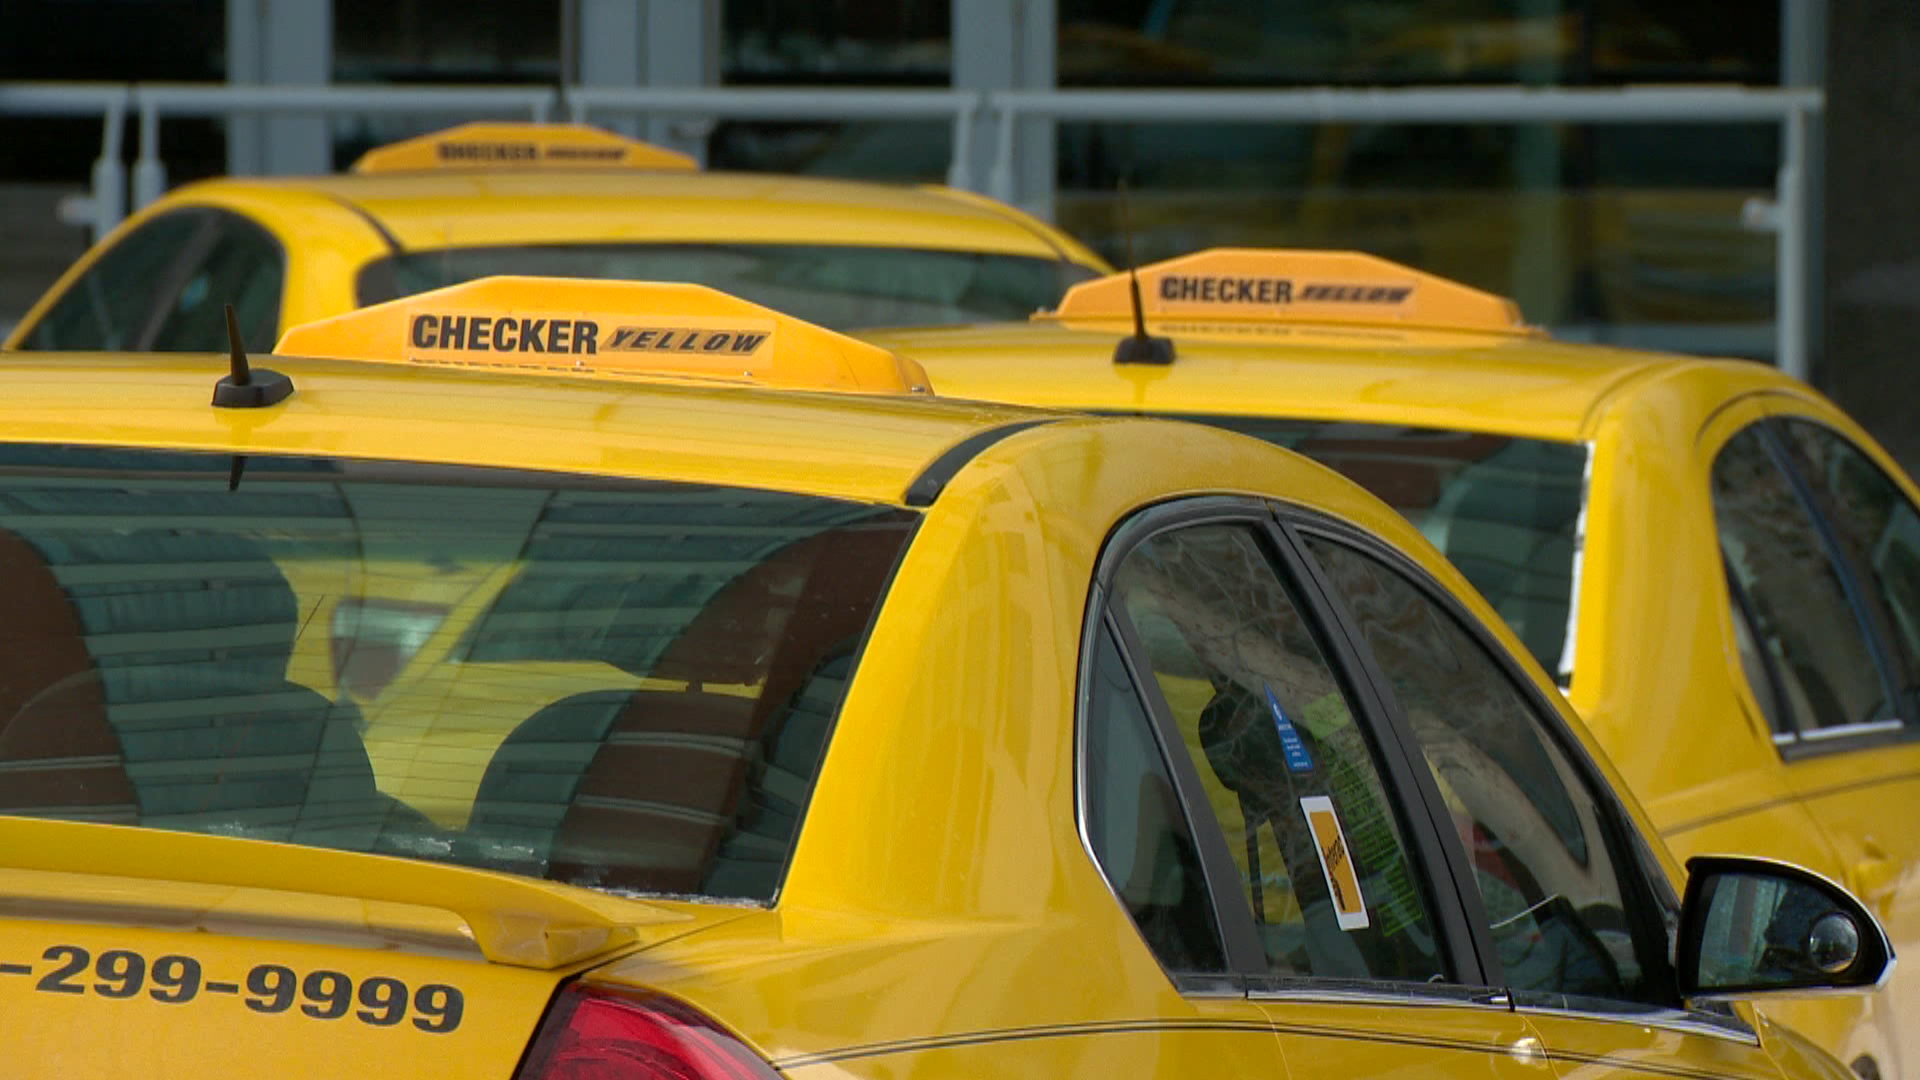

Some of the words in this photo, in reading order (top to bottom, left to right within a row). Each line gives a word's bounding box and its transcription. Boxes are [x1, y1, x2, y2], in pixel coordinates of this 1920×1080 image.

[1160, 276, 1293, 303] CHECKER
[411, 314, 599, 355] CHECKER
[609, 328, 768, 353] YELLOW
